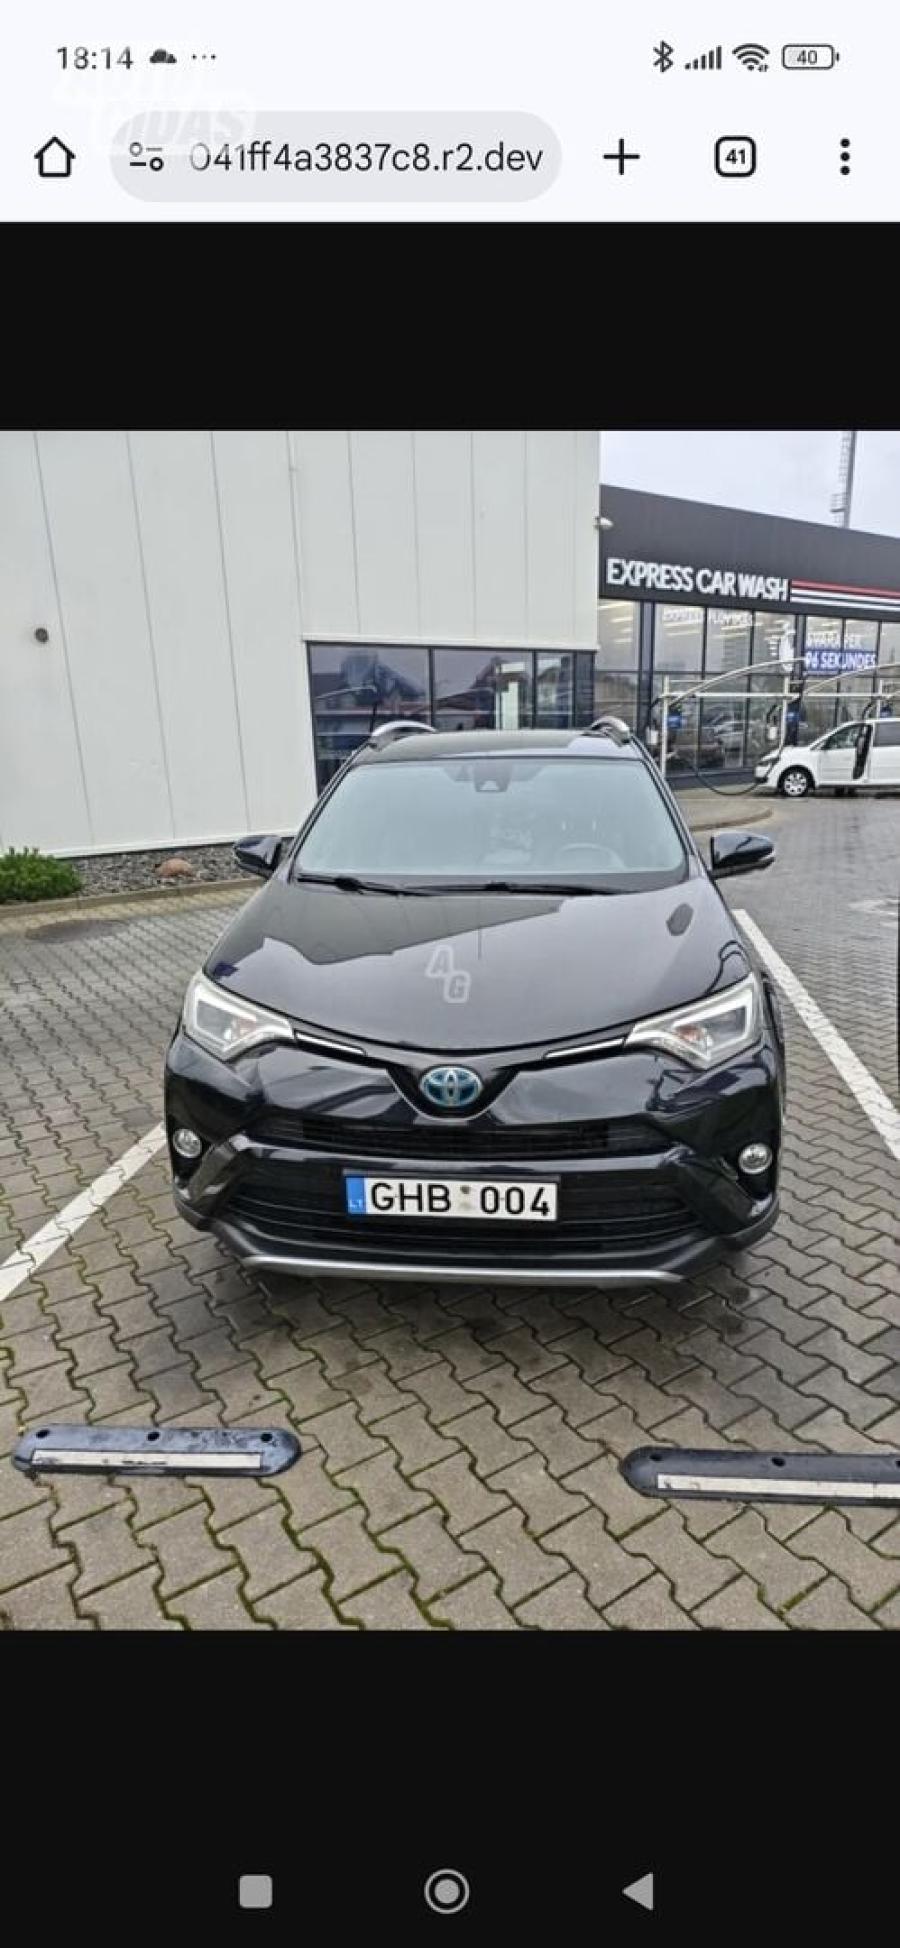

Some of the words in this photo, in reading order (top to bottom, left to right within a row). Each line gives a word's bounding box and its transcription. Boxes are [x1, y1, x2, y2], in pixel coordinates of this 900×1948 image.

[57, 46, 133, 70] 18:14
[796, 50, 818, 65] 40
[189, 141, 544, 173] 041ff4a3837c8.r2.dev
[725, 148, 746, 164] 41
[606, 557, 695, 593] EXPRESS
[696, 567, 737, 597] CAR
[737, 572, 789, 602] WASH
[371, 1182, 451, 1213] GHB
[479, 1185, 550, 1217] 004
